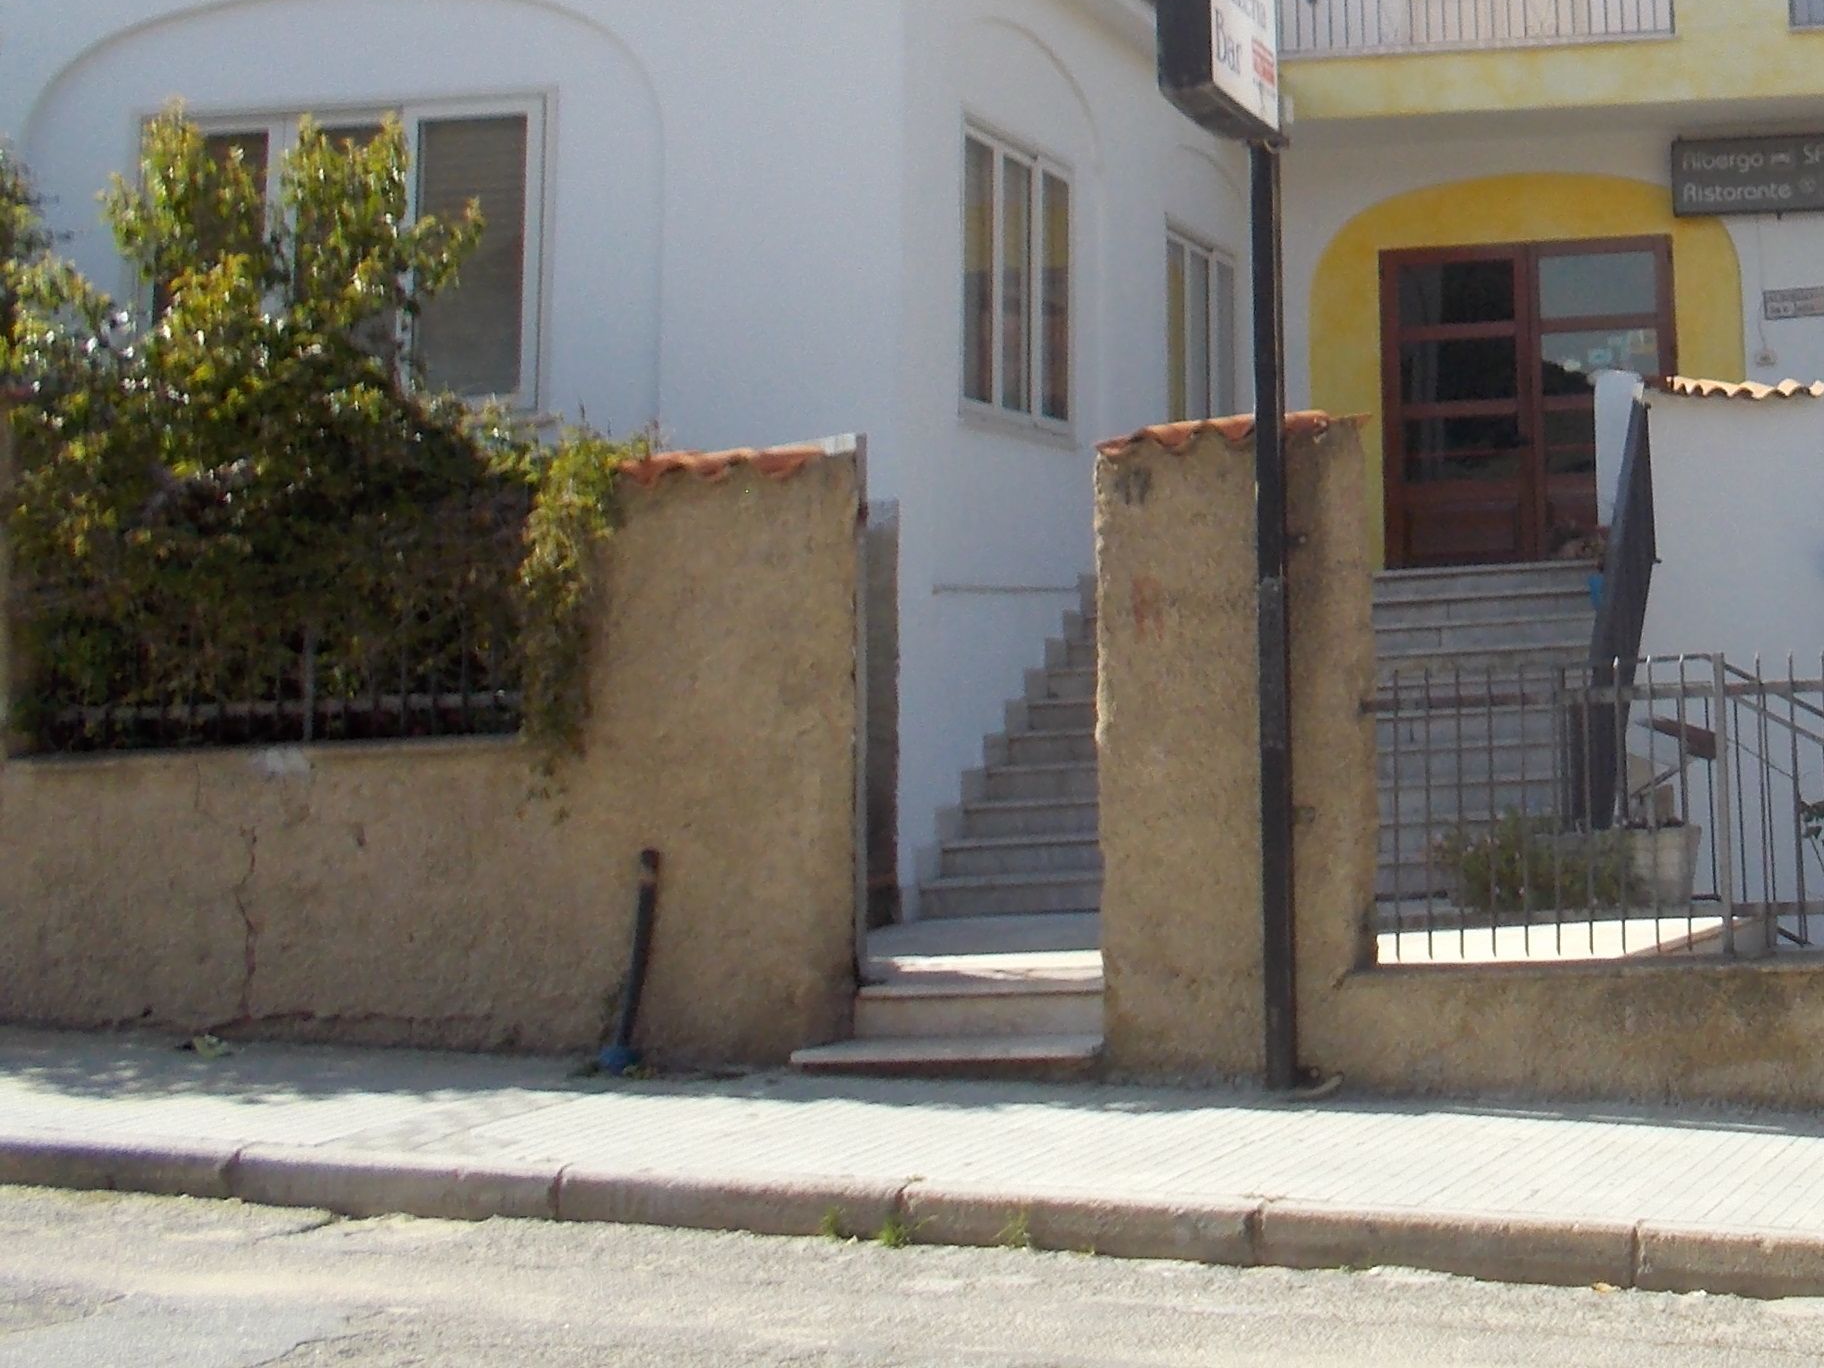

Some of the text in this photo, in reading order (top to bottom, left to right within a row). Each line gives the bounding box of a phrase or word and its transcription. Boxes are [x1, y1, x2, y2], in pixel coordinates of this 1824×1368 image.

[1215, 7, 1242, 75] Bar
[1683, 150, 1764, 173] Albergo
[1683, 182, 1792, 203] Ristorante
